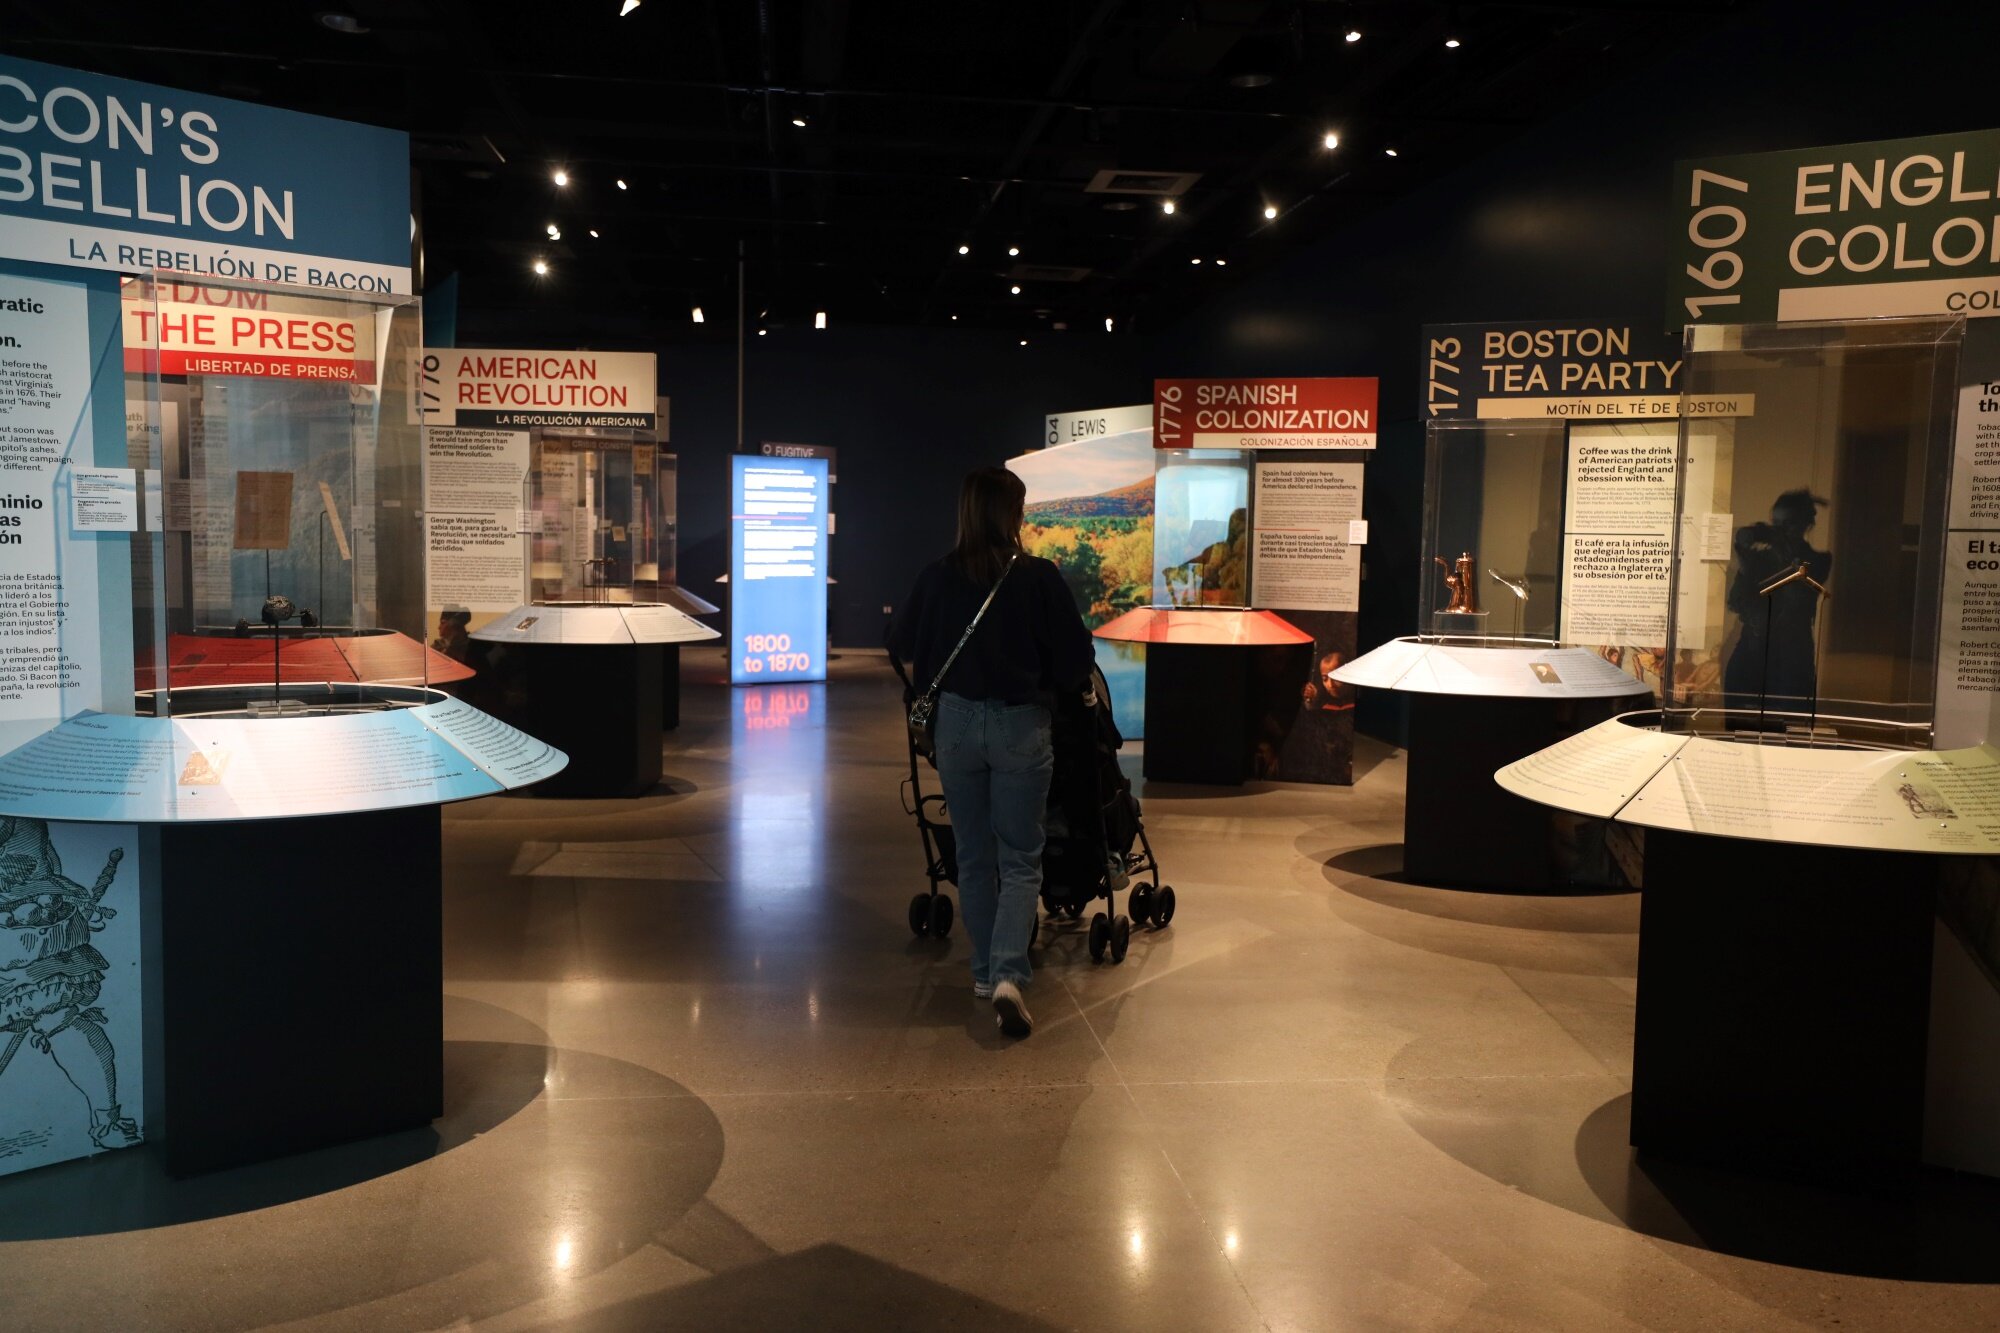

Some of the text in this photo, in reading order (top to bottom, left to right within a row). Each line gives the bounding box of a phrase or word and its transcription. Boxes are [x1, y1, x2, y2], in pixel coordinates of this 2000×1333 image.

[1795, 151, 2000, 215] ENGL
[0, 146, 294, 240] BELLION
[69, 238, 107, 262] LA
[1685, 169, 1748, 319] 1607
[119, 244, 392, 294] REBELIÓN DE BACON
[131, 311, 356, 352] THE PRESS
[1484, 327, 1629, 359] BOSTON
[2, 360, 30, 369] before
[186, 359, 357, 379] LIBERTAD DE PRENSA
[457, 357, 596, 380] AMERICAN
[1429, 338, 1461, 416] 1773
[1482, 361, 1682, 392] TEA PARTY
[17, 389, 37, 397] 1676.
[40, 391, 61, 399] Their
[458, 383, 626, 407] REVOLUTION
[1197, 385, 1297, 405] SPANISH
[1160, 386, 1182, 444] 1776
[1546, 400, 1591, 415] MOTÍN
[1596, 403, 1623, 415] DEL
[1629, 399, 1646, 414] TÉ
[1652, 402, 1670, 414] DE
[496, 413, 647, 427] LA REVOLUCIÓN AMERICANA
[1072, 419, 1106, 436] LEWIS
[1196, 410, 1368, 429] COLONIZATION
[137, 424, 159, 434] King
[1240, 435, 1368, 446] COLONIZACIÓN ESPAÑOLA
[30, 456, 73, 464] campaign,
[1635, 457, 1672, 465] patriots
[1579, 466, 1615, 474] rejected
[1618, 466, 1654, 475] England
[1970, 510, 1998, 519] driving
[1968, 540, 1984, 553] El
[1618, 565, 1661, 573] Inglaterra
[24, 582, 64, 590] británica.
[1965, 581, 1997, 590] Aunque
[1962, 616, 1992, 624] posible
[6, 646, 41, 654] tribales,
[744, 634, 790, 653] 1800
[744, 652, 810, 672] to 1870
[1959, 659, 1981, 667] pipas
